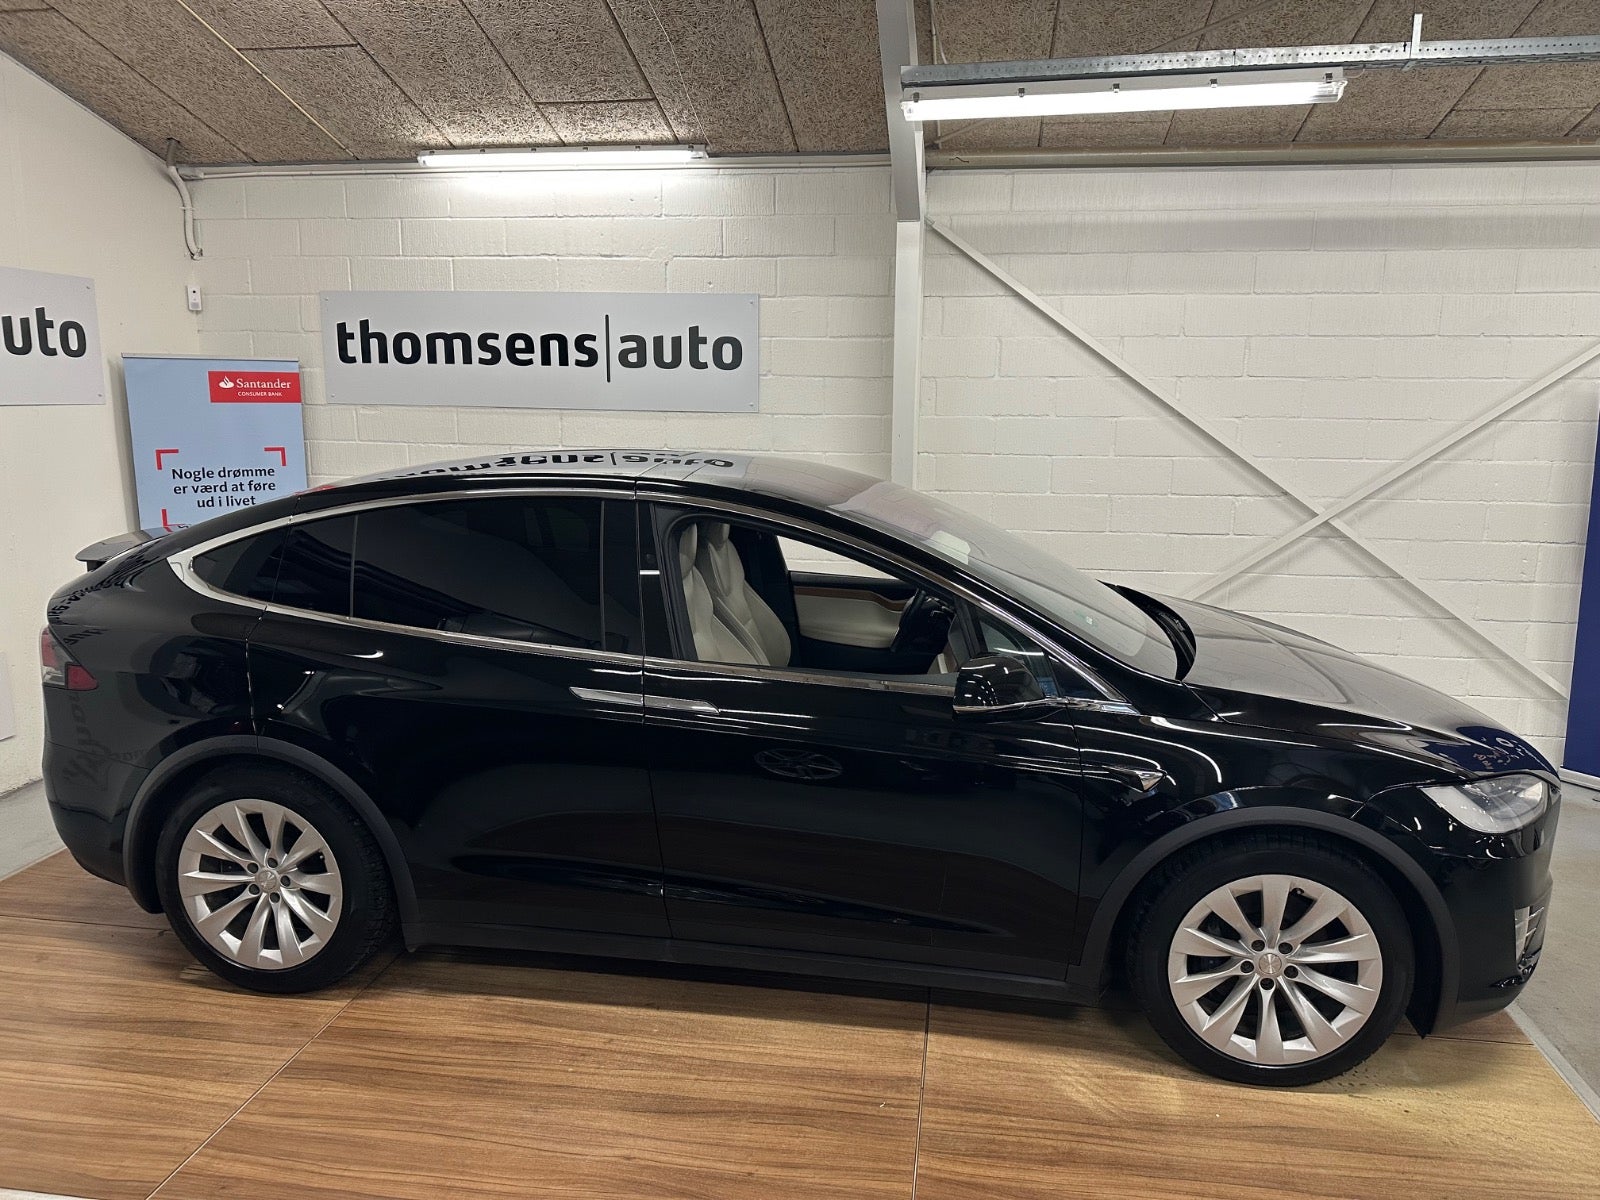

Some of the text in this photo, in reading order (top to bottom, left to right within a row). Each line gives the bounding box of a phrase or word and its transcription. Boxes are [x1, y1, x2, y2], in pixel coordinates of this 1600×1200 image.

[236, 378, 291, 389] Santander
[171, 466, 275, 482] Nogle drømme
[173, 480, 276, 495] er værd at føre
[197, 495, 256, 508] ud i livet
